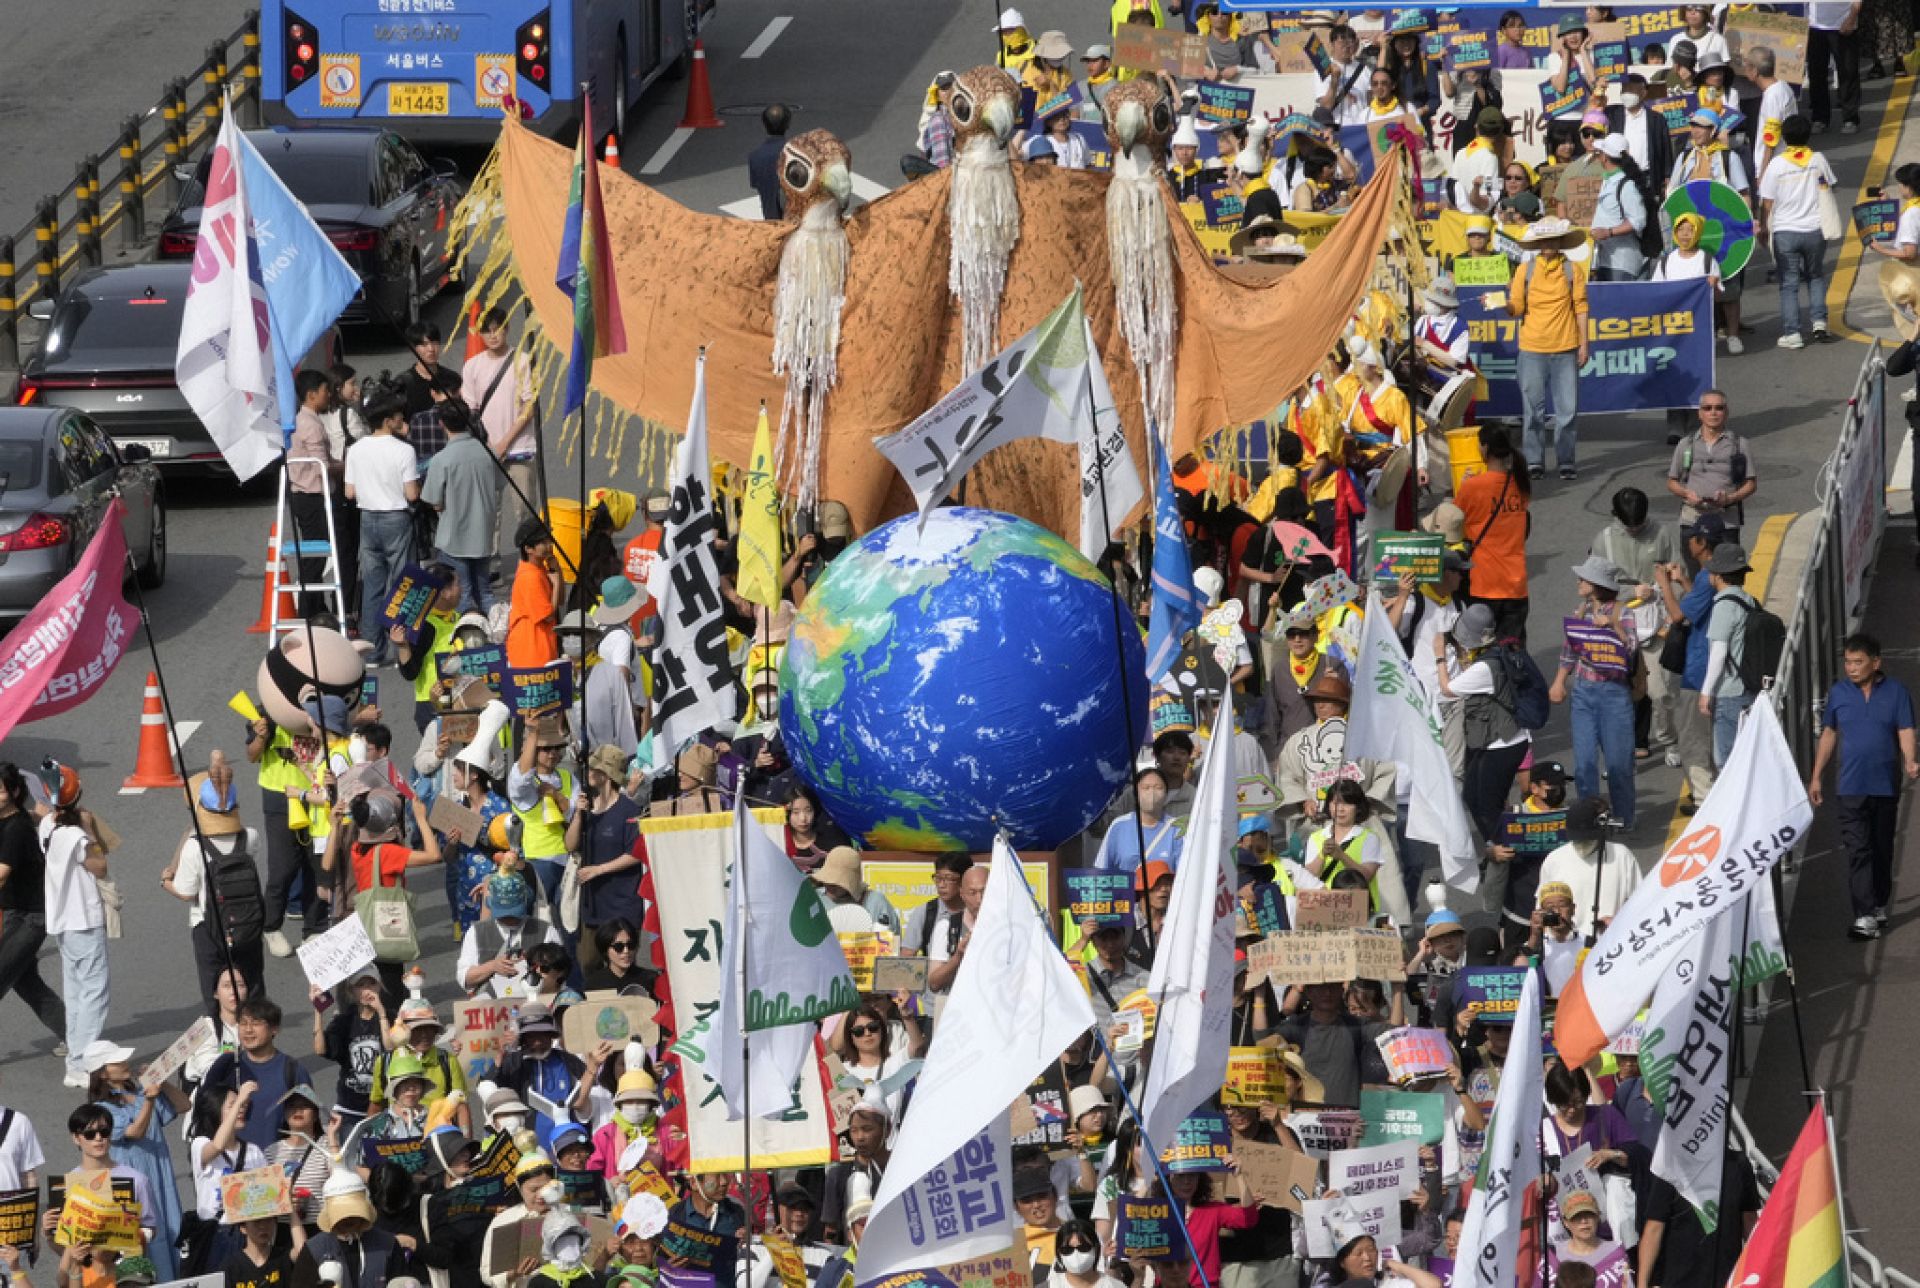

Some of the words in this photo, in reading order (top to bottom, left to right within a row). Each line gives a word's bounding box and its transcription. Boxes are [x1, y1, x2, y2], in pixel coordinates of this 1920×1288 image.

[387, 53, 444, 68] 서울버스
[405, 95, 445, 112] 1443
[1346, 1157, 1405, 1178] 페미니스트
[953, 1126, 1007, 1233] 학교
[1351, 1174, 1400, 1195] 기후정의
[923, 1164, 960, 1241] 위원회
